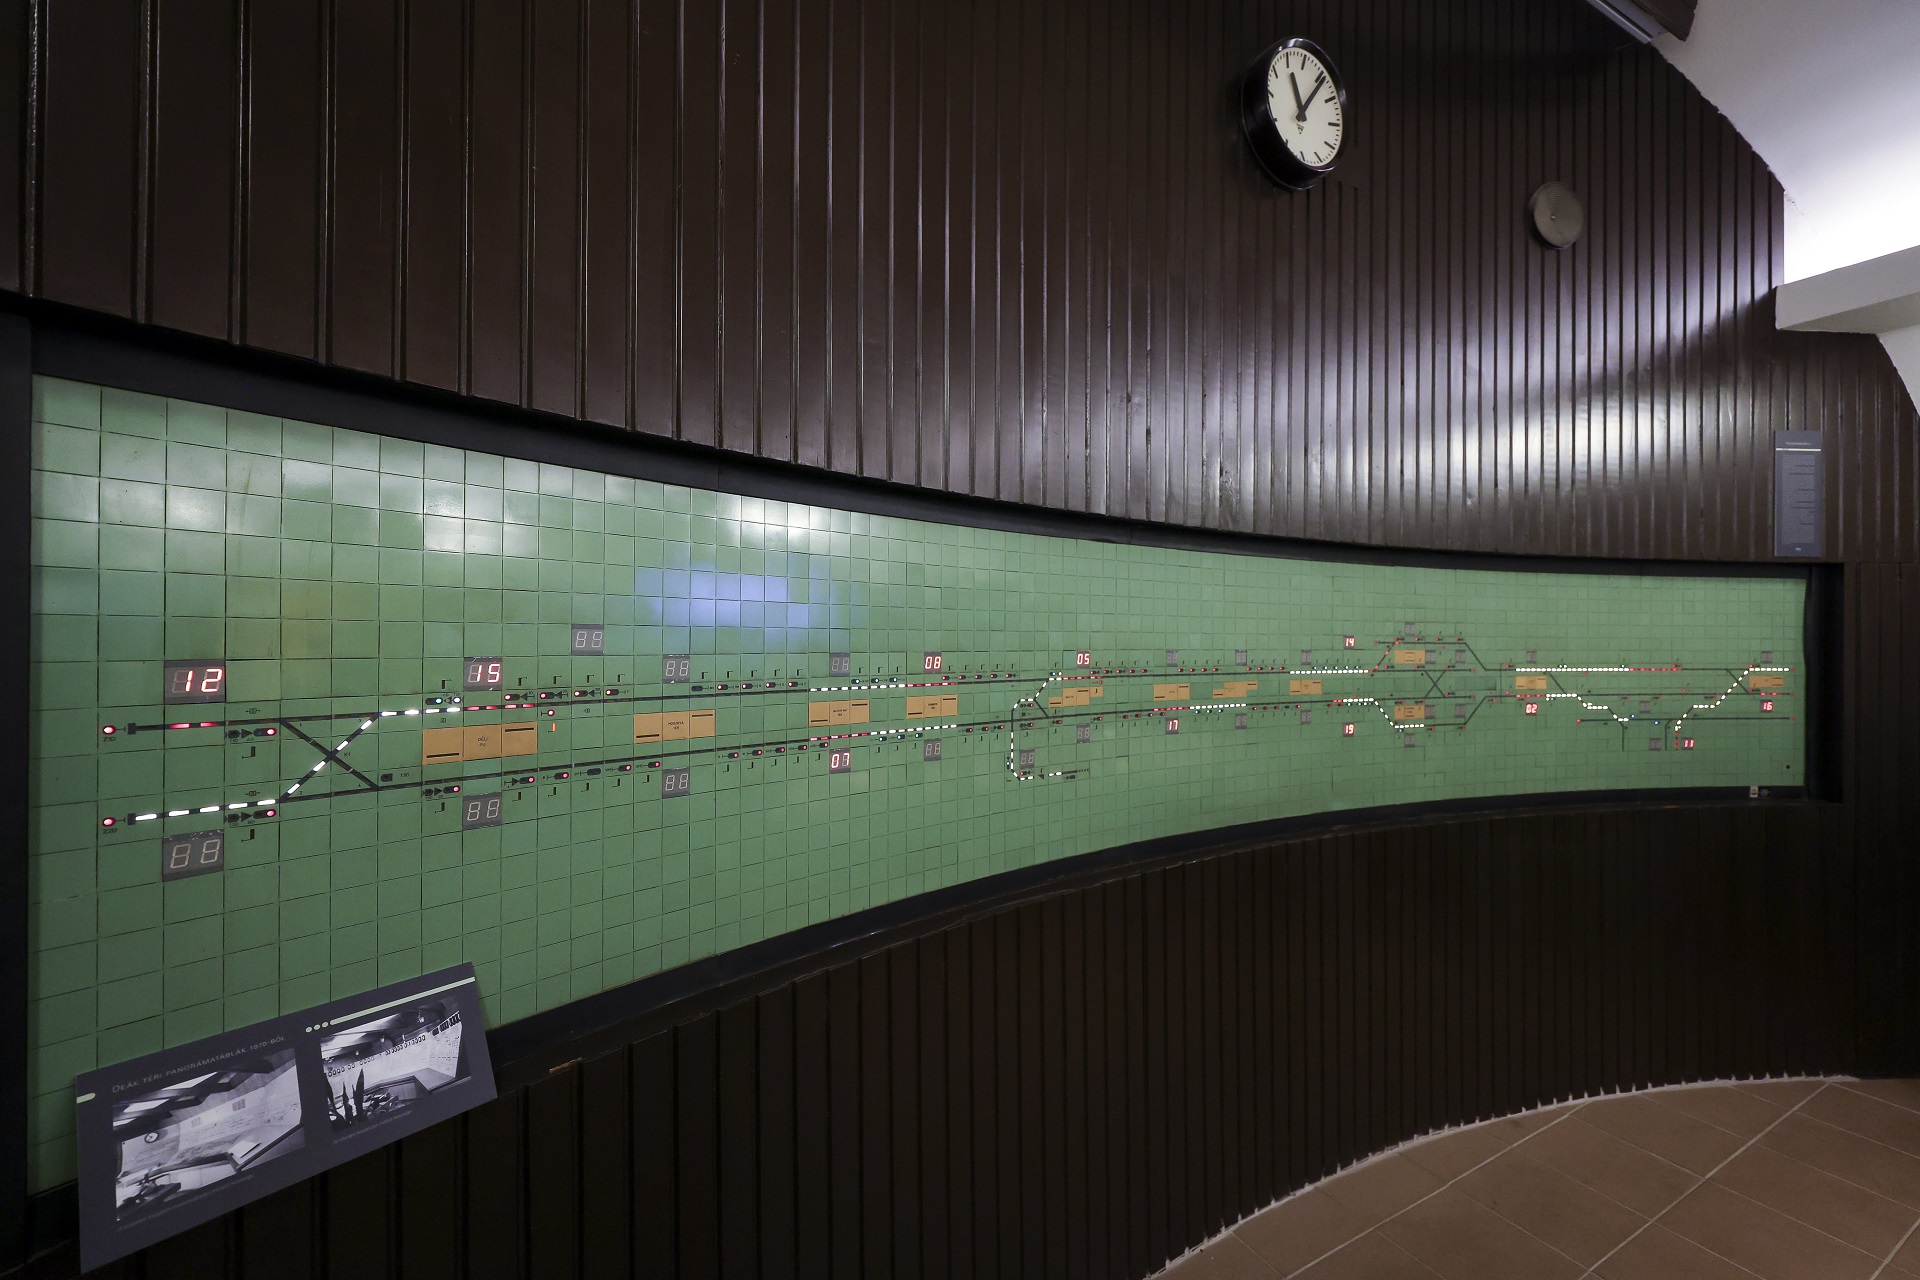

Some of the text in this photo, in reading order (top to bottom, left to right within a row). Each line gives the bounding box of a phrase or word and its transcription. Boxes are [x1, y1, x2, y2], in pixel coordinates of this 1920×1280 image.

[1345, 637, 1355, 647] 14
[924, 656, 942, 670] 08
[1076, 653, 1090, 665] 05
[476, 663, 501, 683] 15
[185, 668, 224, 693] 12
[1525, 703, 1538, 714] 02
[1762, 701, 1773, 711] 16
[1168, 719, 1179, 731] 17
[1345, 723, 1355, 735] 19
[1684, 739, 1695, 748] 11
[831, 752, 850, 769] 07
